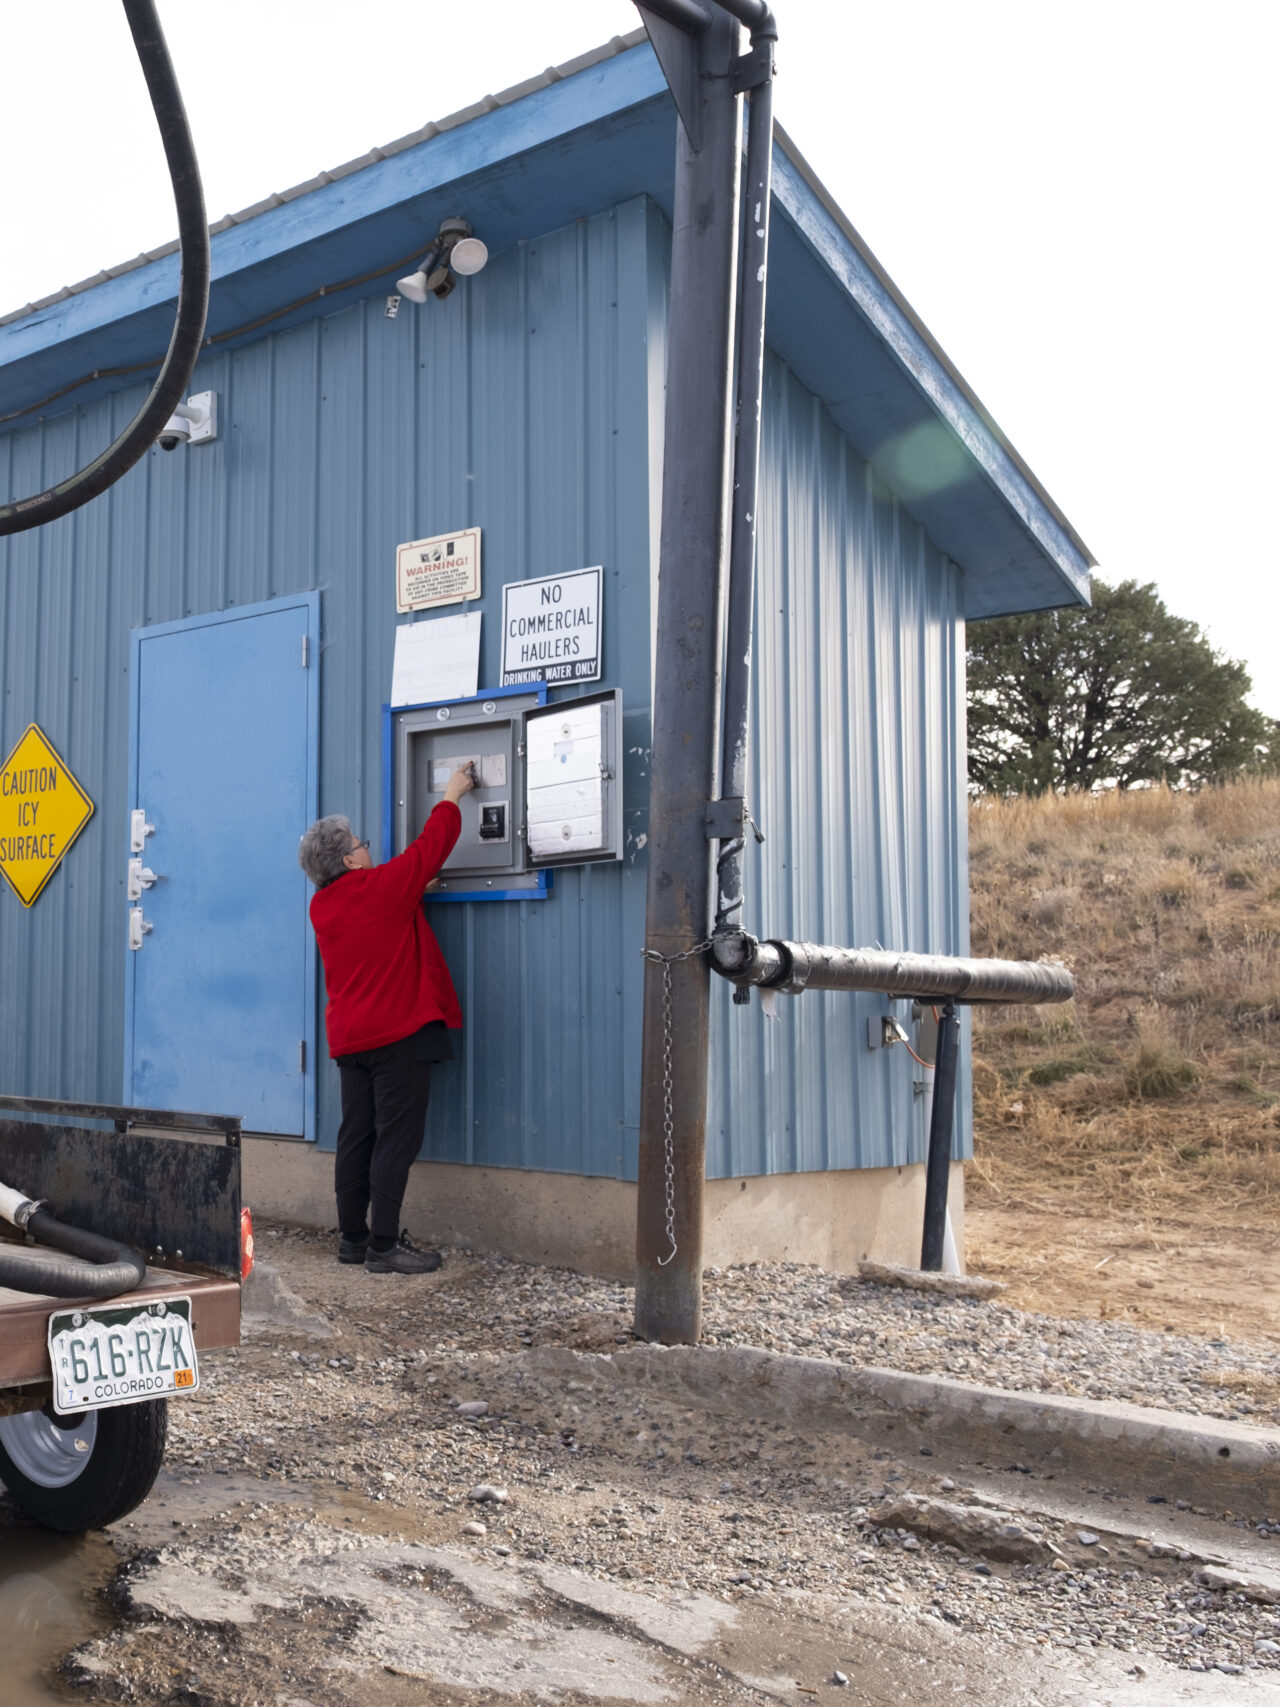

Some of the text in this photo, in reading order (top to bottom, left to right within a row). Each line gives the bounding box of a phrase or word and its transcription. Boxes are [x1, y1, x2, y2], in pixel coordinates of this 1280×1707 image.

[406, 556, 468, 577] WARNING!
[425, 570, 448, 578] ACTIVITIES
[443, 586, 463, 594] FACILITY
[541, 584, 562, 605] NO
[510, 606, 594, 638] COMMERCIAL
[521, 636, 580, 663] HAULERS
[504, 660, 597, 686] DRINKING WATER ONLY
[2, 766, 57, 796] CAUTION
[18, 801, 40, 827] ICY
[0, 834, 56, 862] SURFACE
[94, 1376, 164, 1398] COLORADO
[177, 1373, 187, 1384] 21
